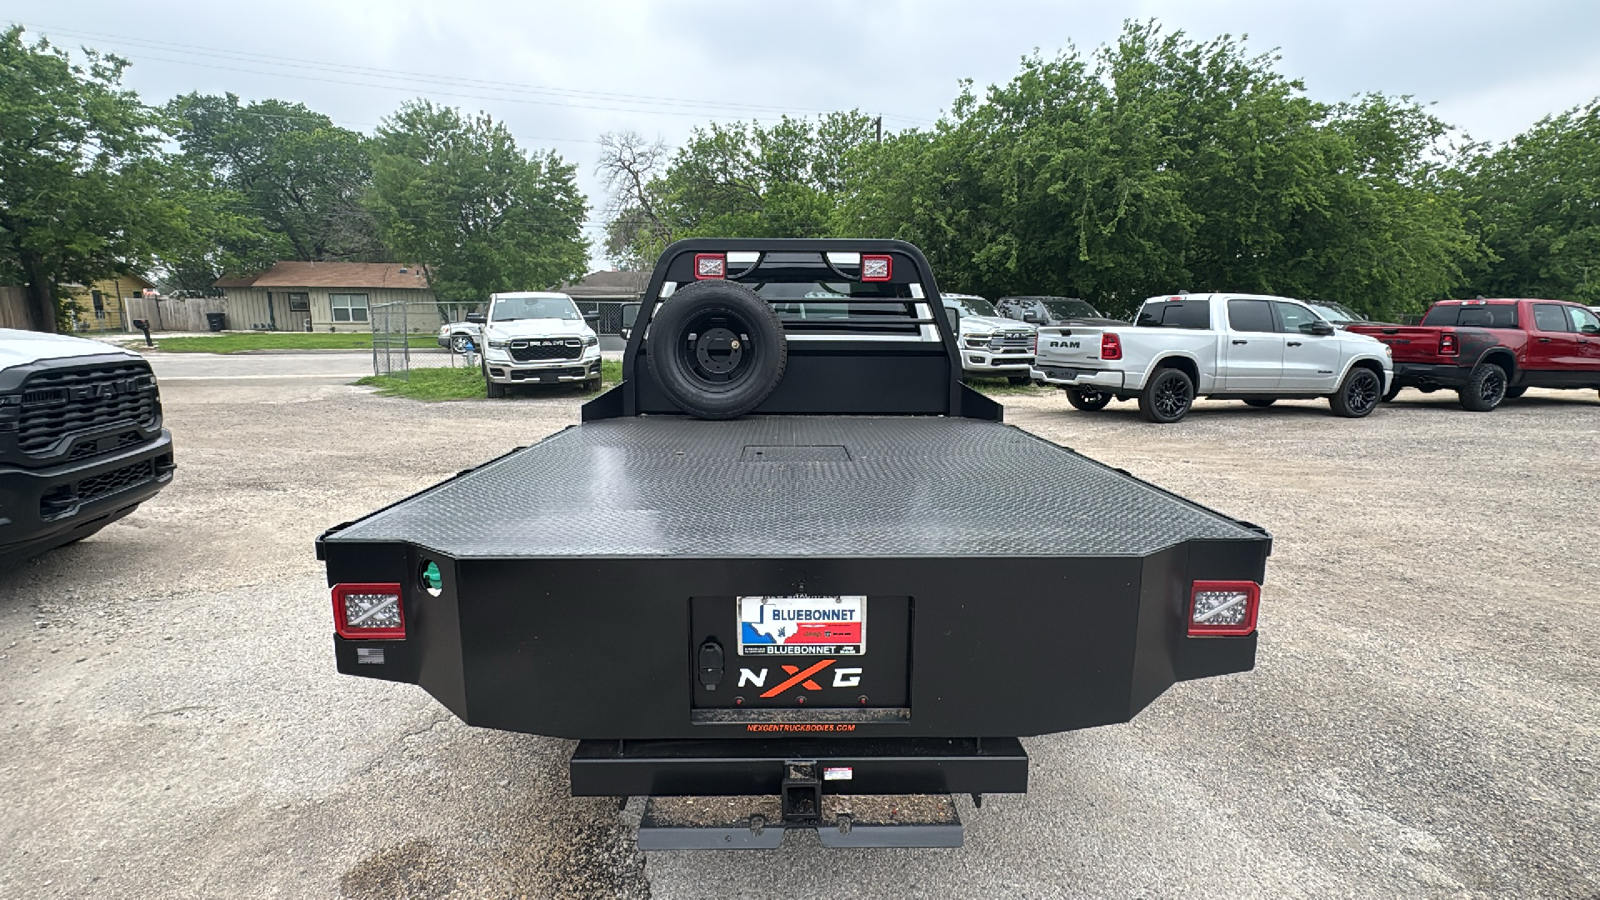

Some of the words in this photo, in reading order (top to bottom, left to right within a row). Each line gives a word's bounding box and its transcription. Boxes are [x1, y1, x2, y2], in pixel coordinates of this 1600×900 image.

[1049, 341, 1081, 349] RAM
[772, 609, 856, 621] BLUEBONNET
[767, 646, 837, 654] BLUEBONNET
[747, 724, 856, 732] NEXGENTRUCKBODIES.COM
